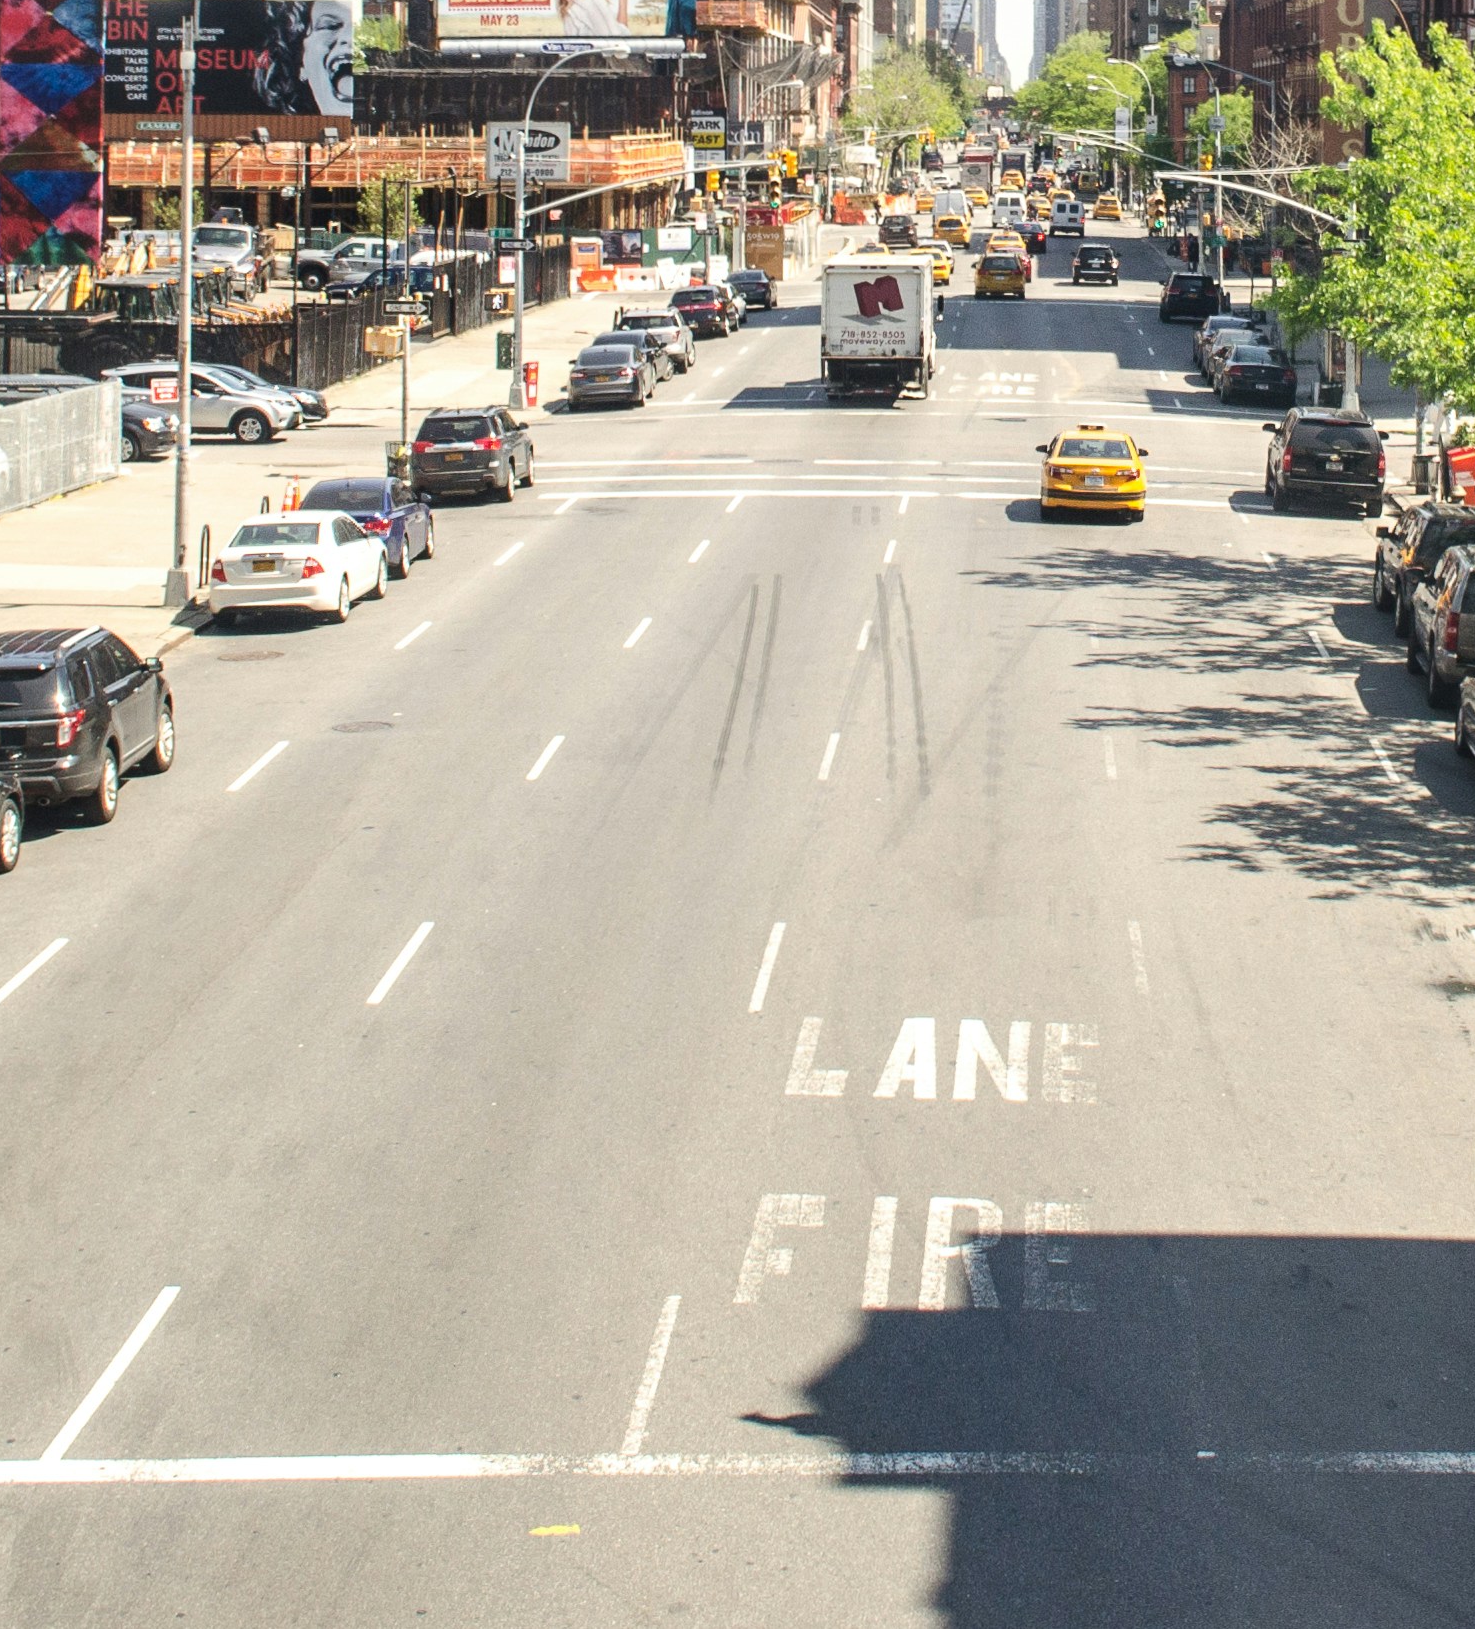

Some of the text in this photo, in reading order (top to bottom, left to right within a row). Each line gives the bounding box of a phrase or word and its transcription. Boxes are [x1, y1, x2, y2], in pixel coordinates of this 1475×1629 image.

[480, 14, 519, 27] MAY 23
[124, 57, 149, 65] TALKS
[155, 49, 270, 70] MSEUM
[124, 66, 149, 74] FILMS
[127, 93, 148, 101] CAFE
[691, 120, 721, 130] PARK
[692, 134, 721, 144] FAST
[840, 338, 906, 347] moveway.com
[784, 1015, 1101, 1104] LANE
[732, 1192, 1098, 1313] FIRE
